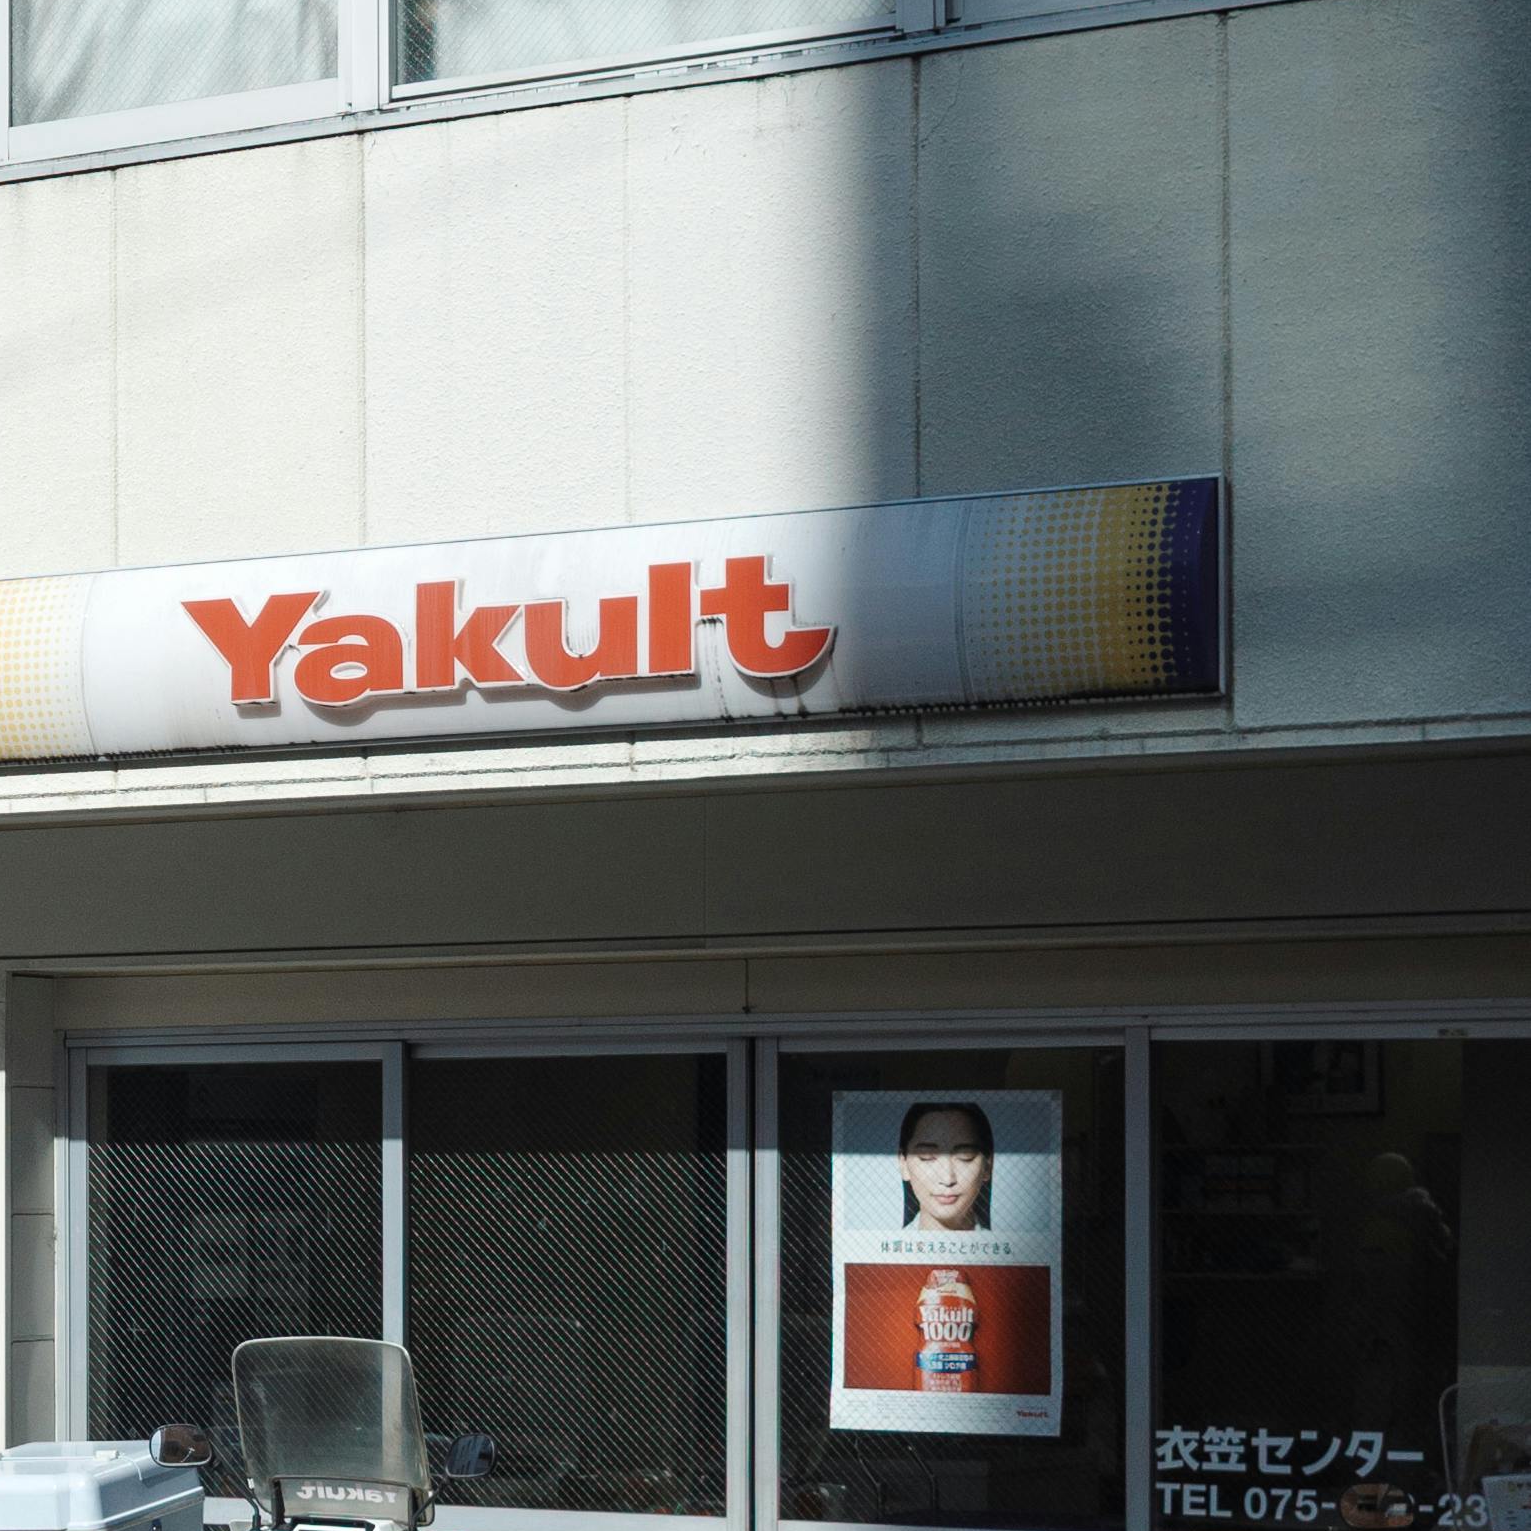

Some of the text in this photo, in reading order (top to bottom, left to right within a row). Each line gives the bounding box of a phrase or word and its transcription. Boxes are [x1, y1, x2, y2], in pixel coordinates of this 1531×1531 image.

[180, 555, 833, 708] Yakult
[919, 1306, 974, 1322] Yakult
[920, 1323, 973, 1341] 1000
[1155, 1425, 1424, 1477] 衣笠センター
[1155, 1482, 1232, 1518] TEL
